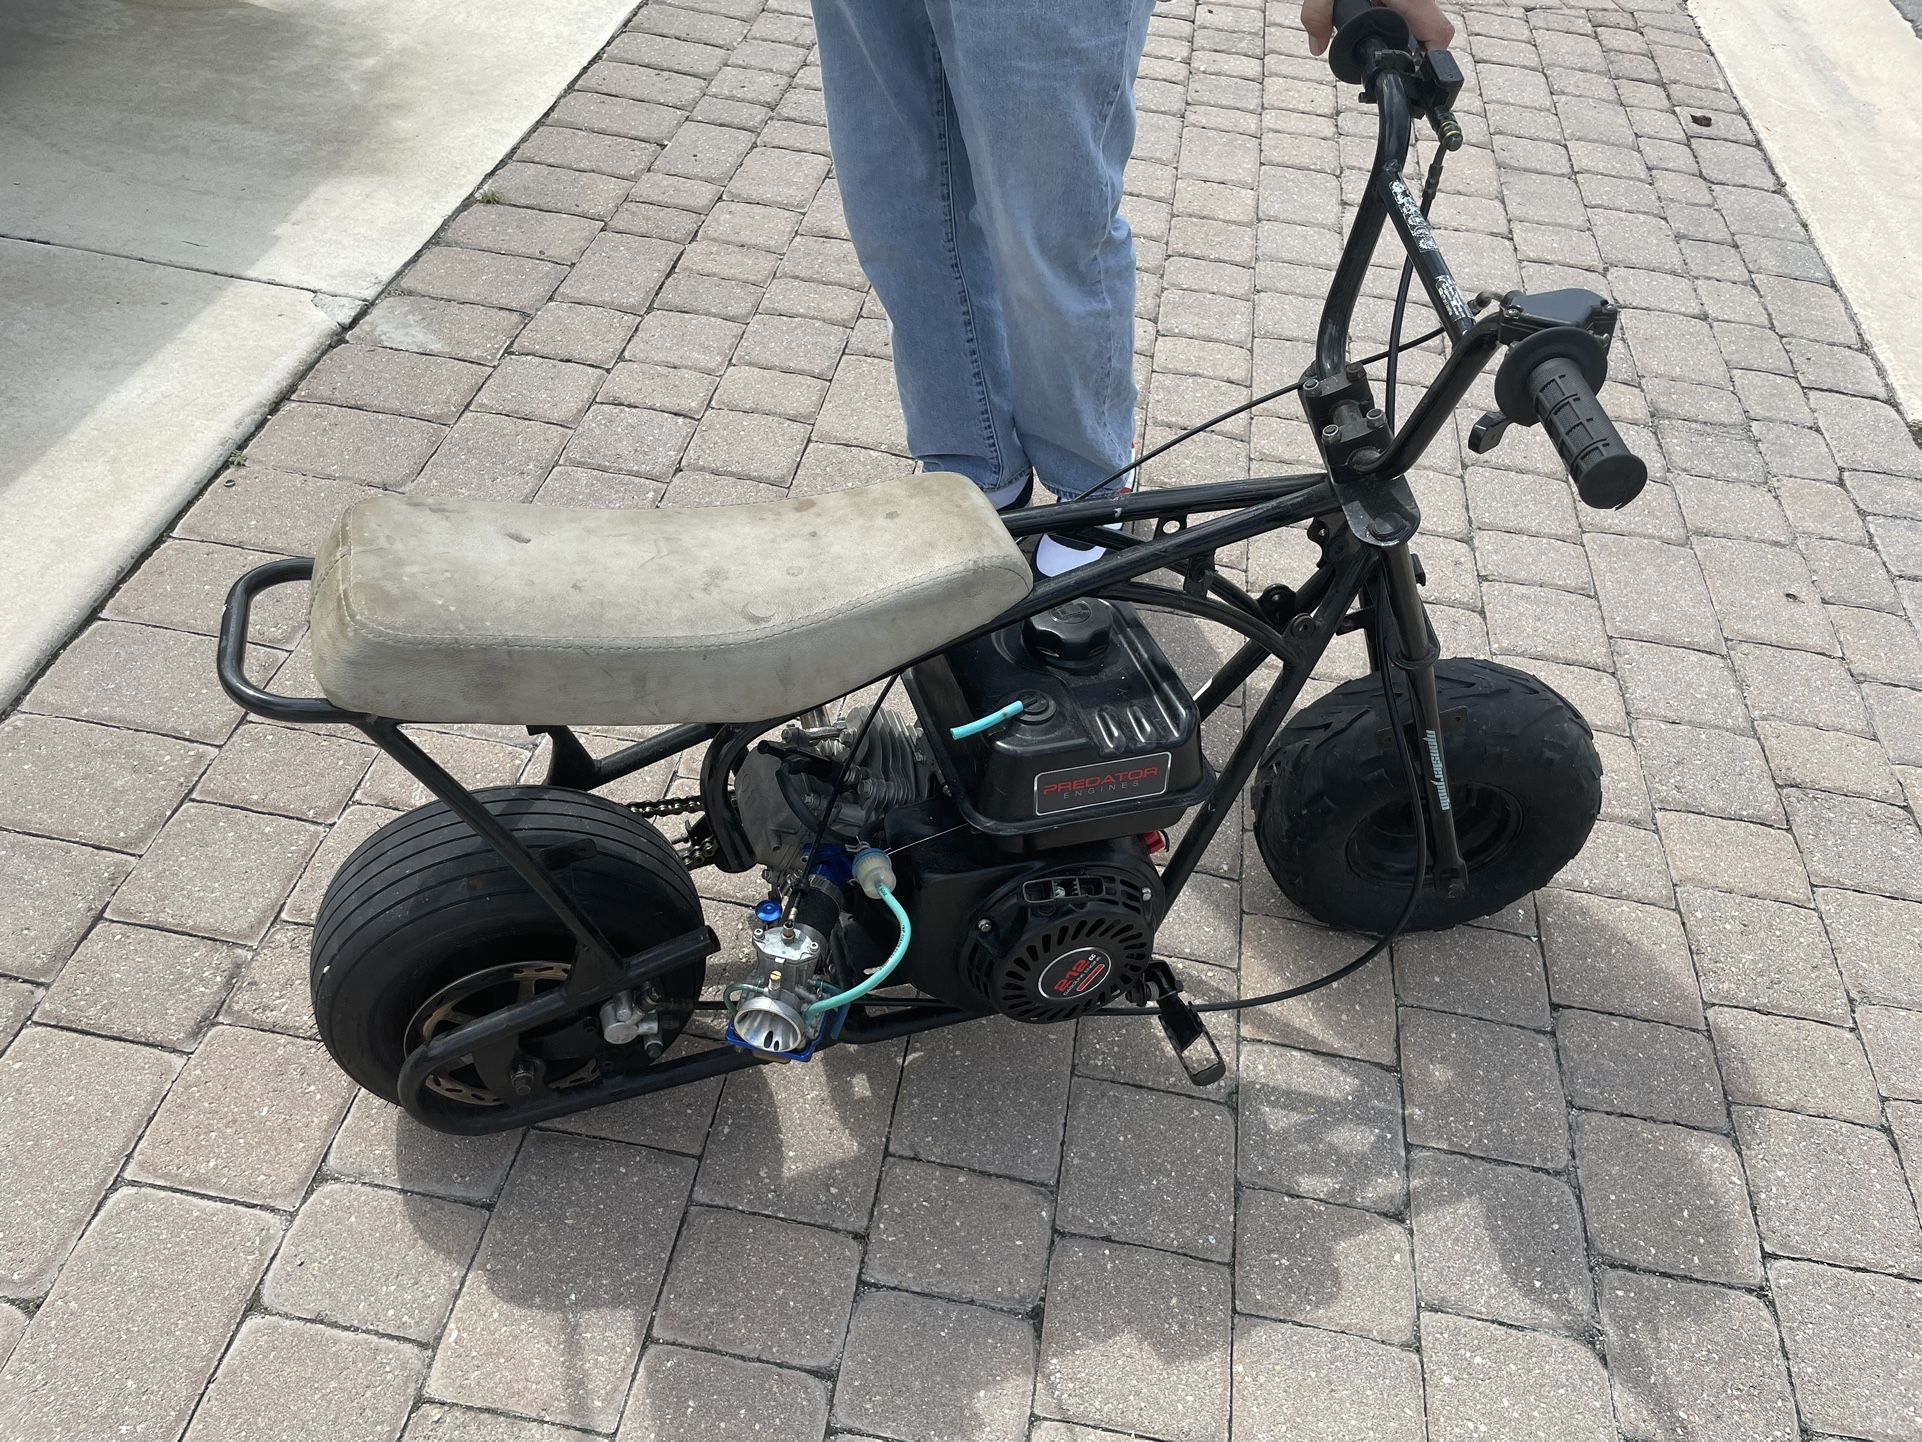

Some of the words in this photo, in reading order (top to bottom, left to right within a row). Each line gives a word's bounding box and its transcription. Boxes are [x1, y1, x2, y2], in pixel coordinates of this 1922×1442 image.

[1042, 767, 1158, 795] PREDATOR
[1064, 781, 1138, 799] ENGINES
[1053, 959, 1090, 992] 212
